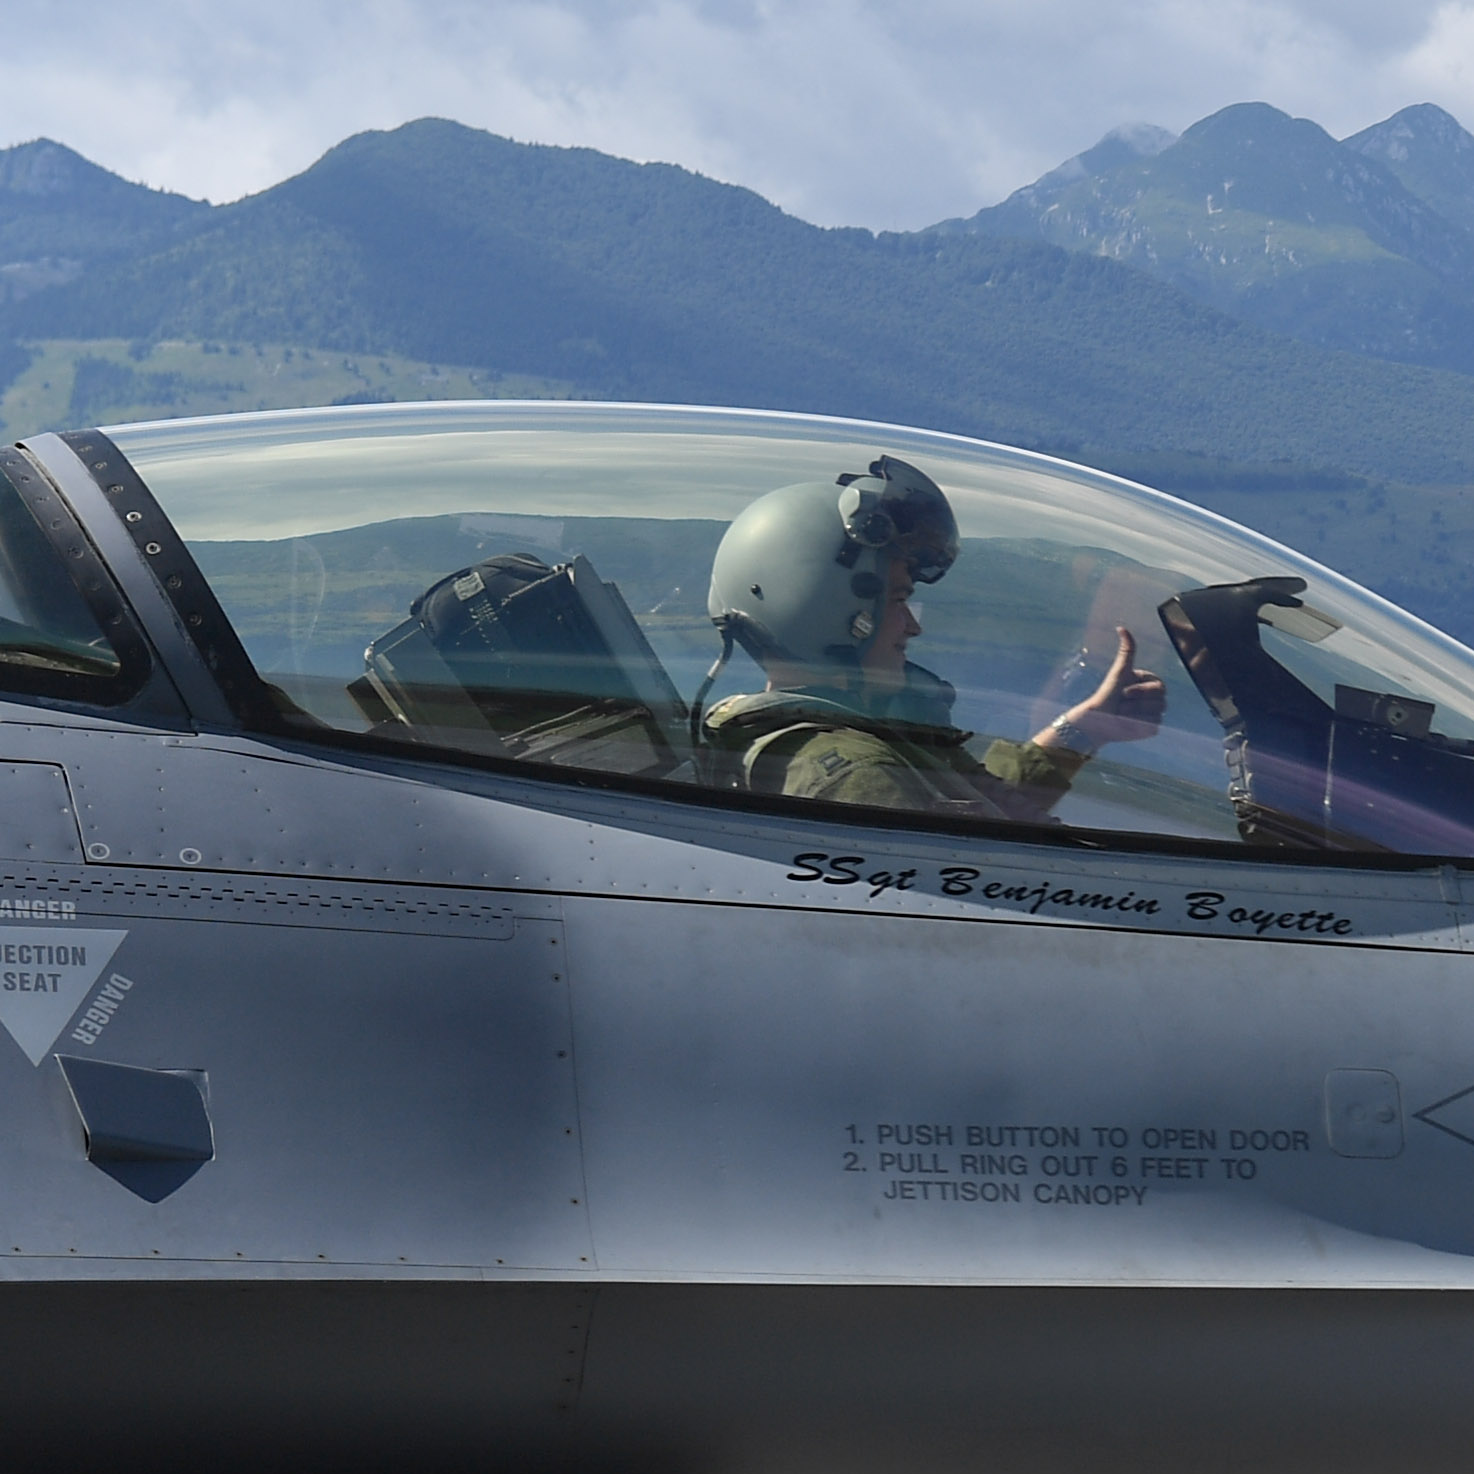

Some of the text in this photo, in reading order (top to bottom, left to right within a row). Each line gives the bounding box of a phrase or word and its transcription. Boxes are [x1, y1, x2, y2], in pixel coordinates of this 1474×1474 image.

[786, 853, 1353, 935] SSgt Benjamin Boyette
[0, 944, 86, 966] ECTION
[3, 971, 62, 993] SEAT
[72, 972, 134, 1045] DANGER
[844, 1124, 1310, 1151] 1. PUSH BUTTON TO OPEN DOOR
[843, 1151, 1257, 1180] 2. PULL RING OUT 6 FEET TO
[884, 1180, 1148, 1206] JETTISON CANOPY
